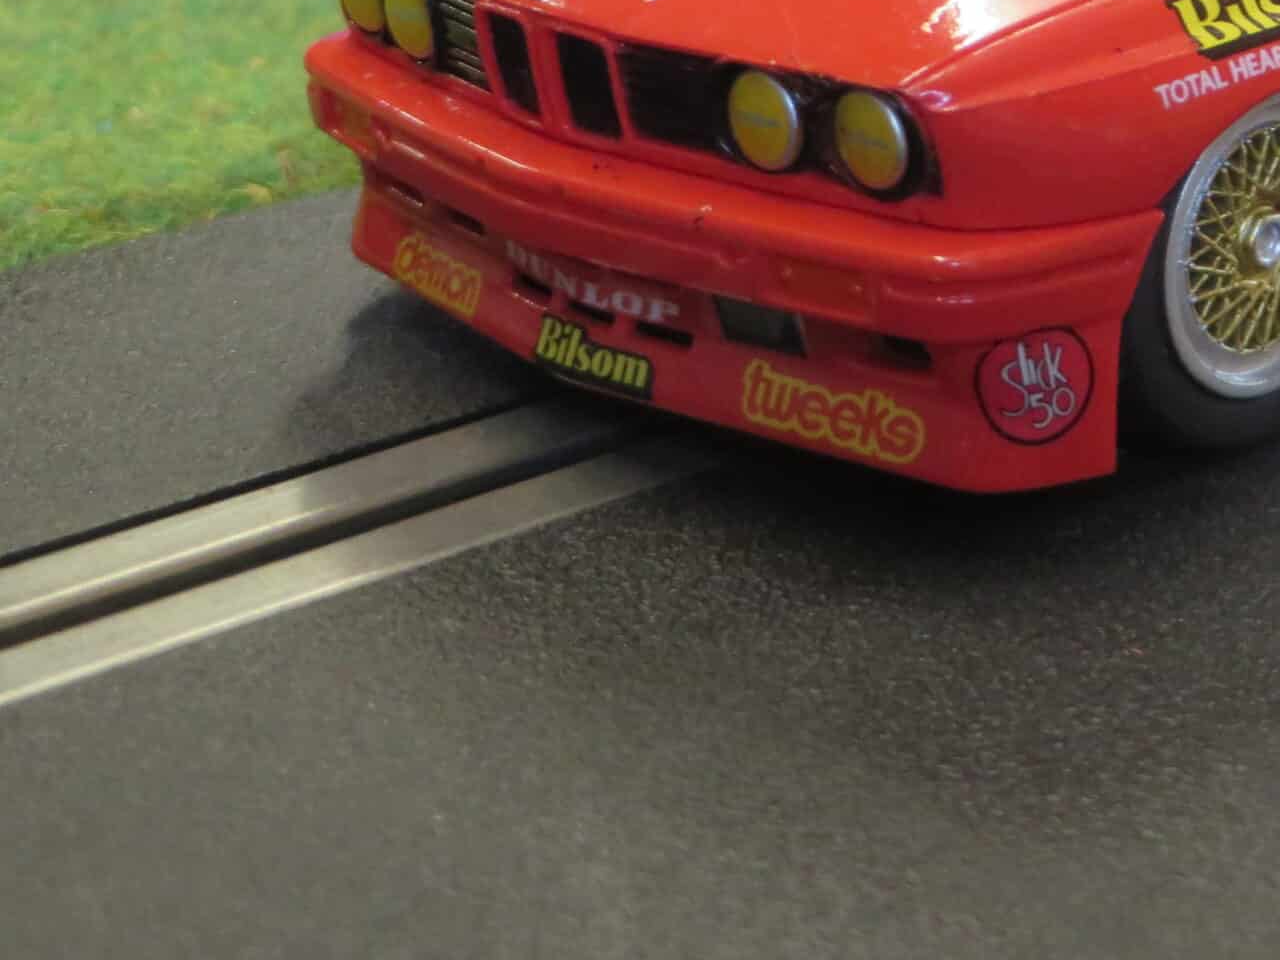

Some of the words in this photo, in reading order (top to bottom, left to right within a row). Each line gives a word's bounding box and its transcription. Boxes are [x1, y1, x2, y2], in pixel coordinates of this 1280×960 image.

[1154, 65, 1228, 109] TOTAL
[506, 239, 681, 322] DUNLOP
[536, 316, 650, 389] Bilsom
[1030, 385, 1076, 430] 50
